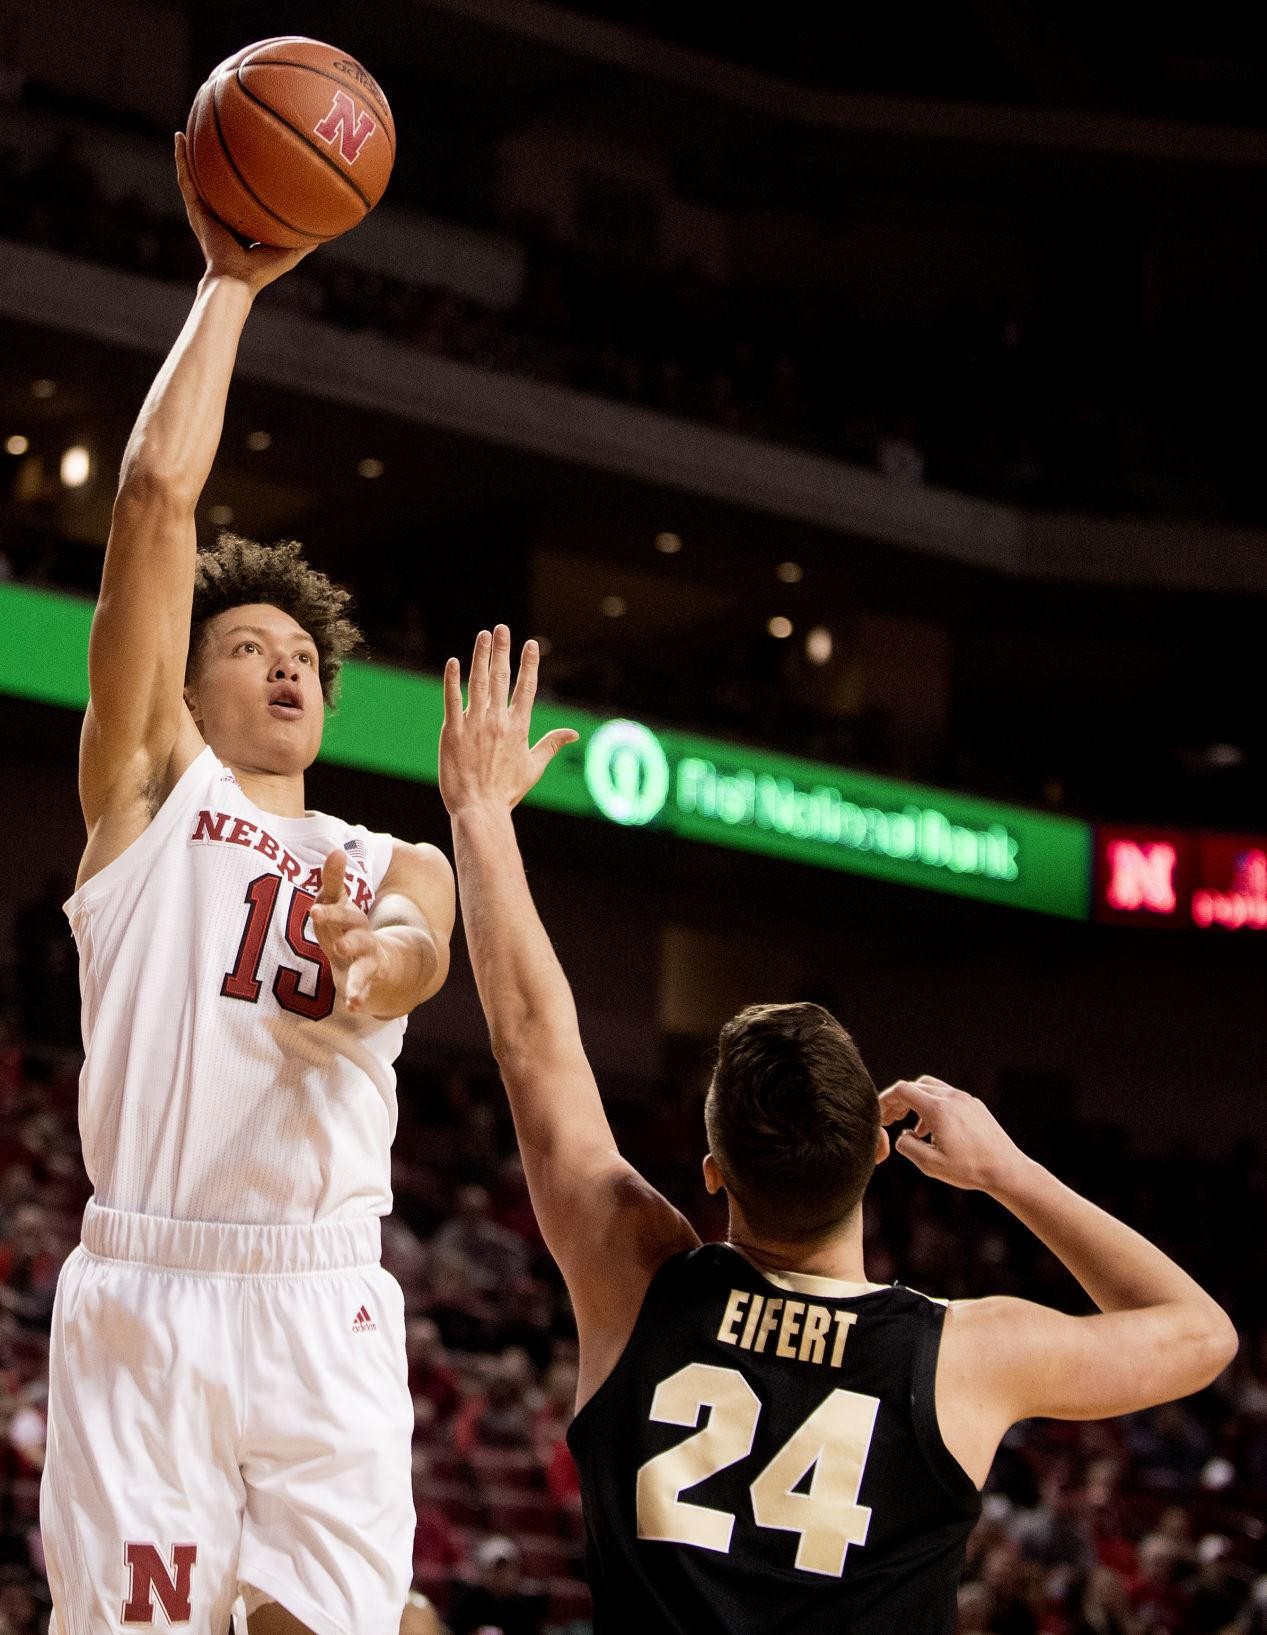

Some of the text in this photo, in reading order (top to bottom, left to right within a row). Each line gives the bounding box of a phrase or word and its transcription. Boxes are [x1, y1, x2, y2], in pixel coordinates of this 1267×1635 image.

[314, 90, 376, 165] N
[220, 872, 336, 1021] 15
[716, 1289, 858, 1368] EIFERT
[636, 1362, 880, 1577] 24
[120, 1541, 198, 1625] N
